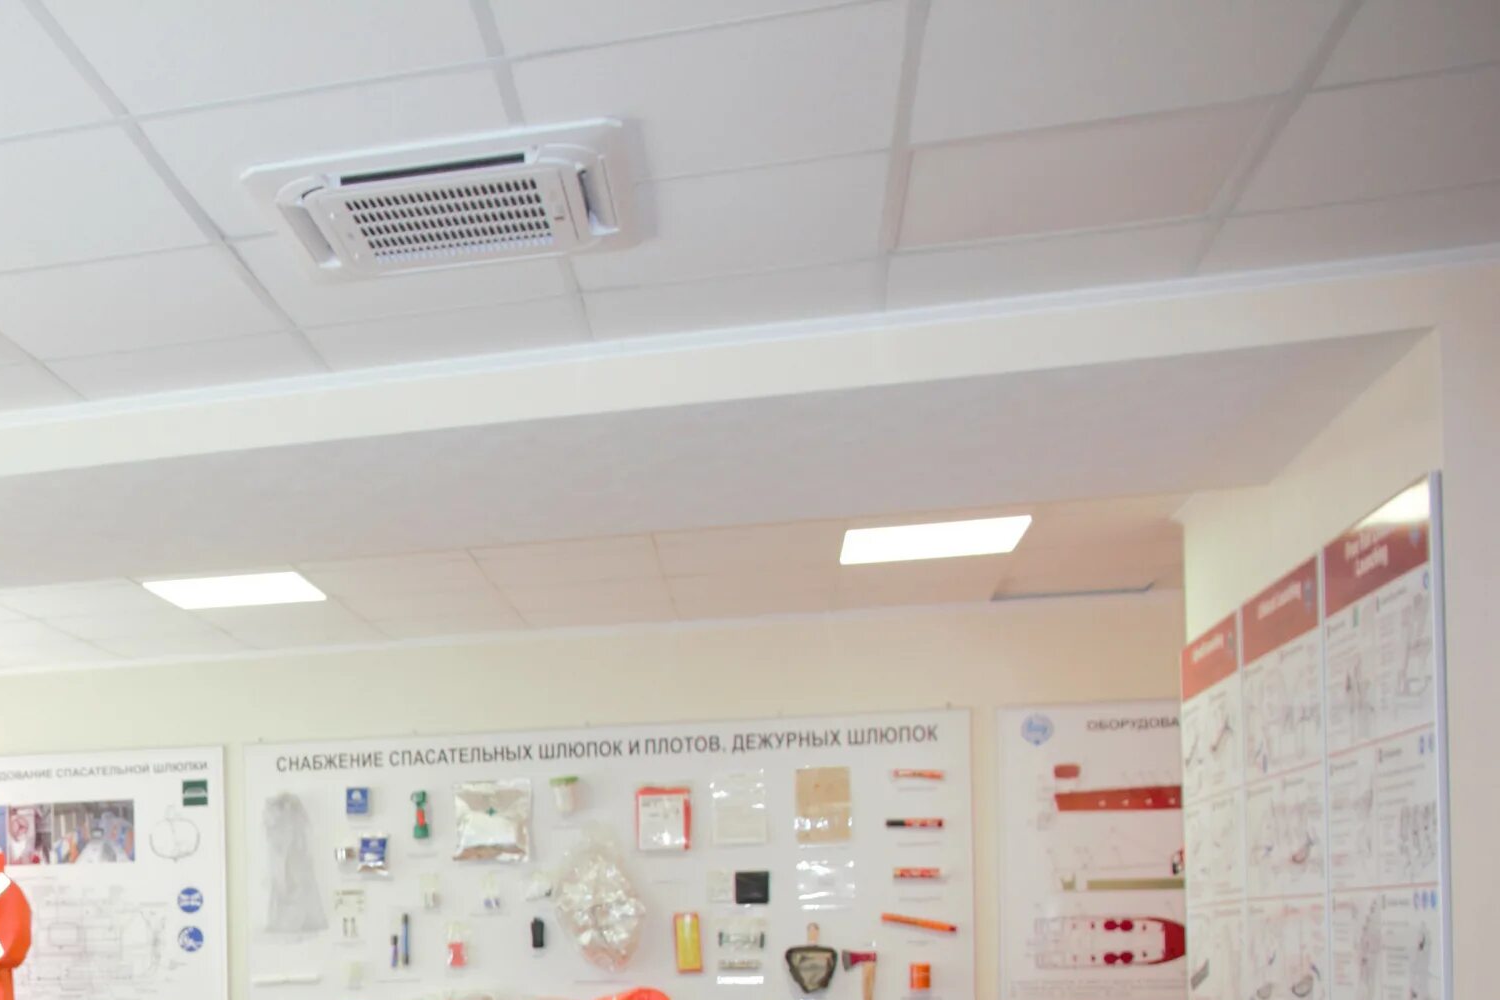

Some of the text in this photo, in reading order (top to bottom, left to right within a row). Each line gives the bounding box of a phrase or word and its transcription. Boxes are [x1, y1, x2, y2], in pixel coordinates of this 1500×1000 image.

[276, 751, 384, 772] СНАБЖЕНИЕ
[389, 744, 533, 767] СПАСАТЕЛЬНЫХ
[538, 740, 622, 759] ШЛЮПОК
[628, 740, 640, 756] И
[731, 729, 841, 755] ДЕЖУРНЫХ
[848, 724, 938, 746] ШЛЮПОК
[56, 763, 150, 778] СПАСАТЕЛЬНОЙ
[153, 760, 209, 774] ШЛЮПКИ
